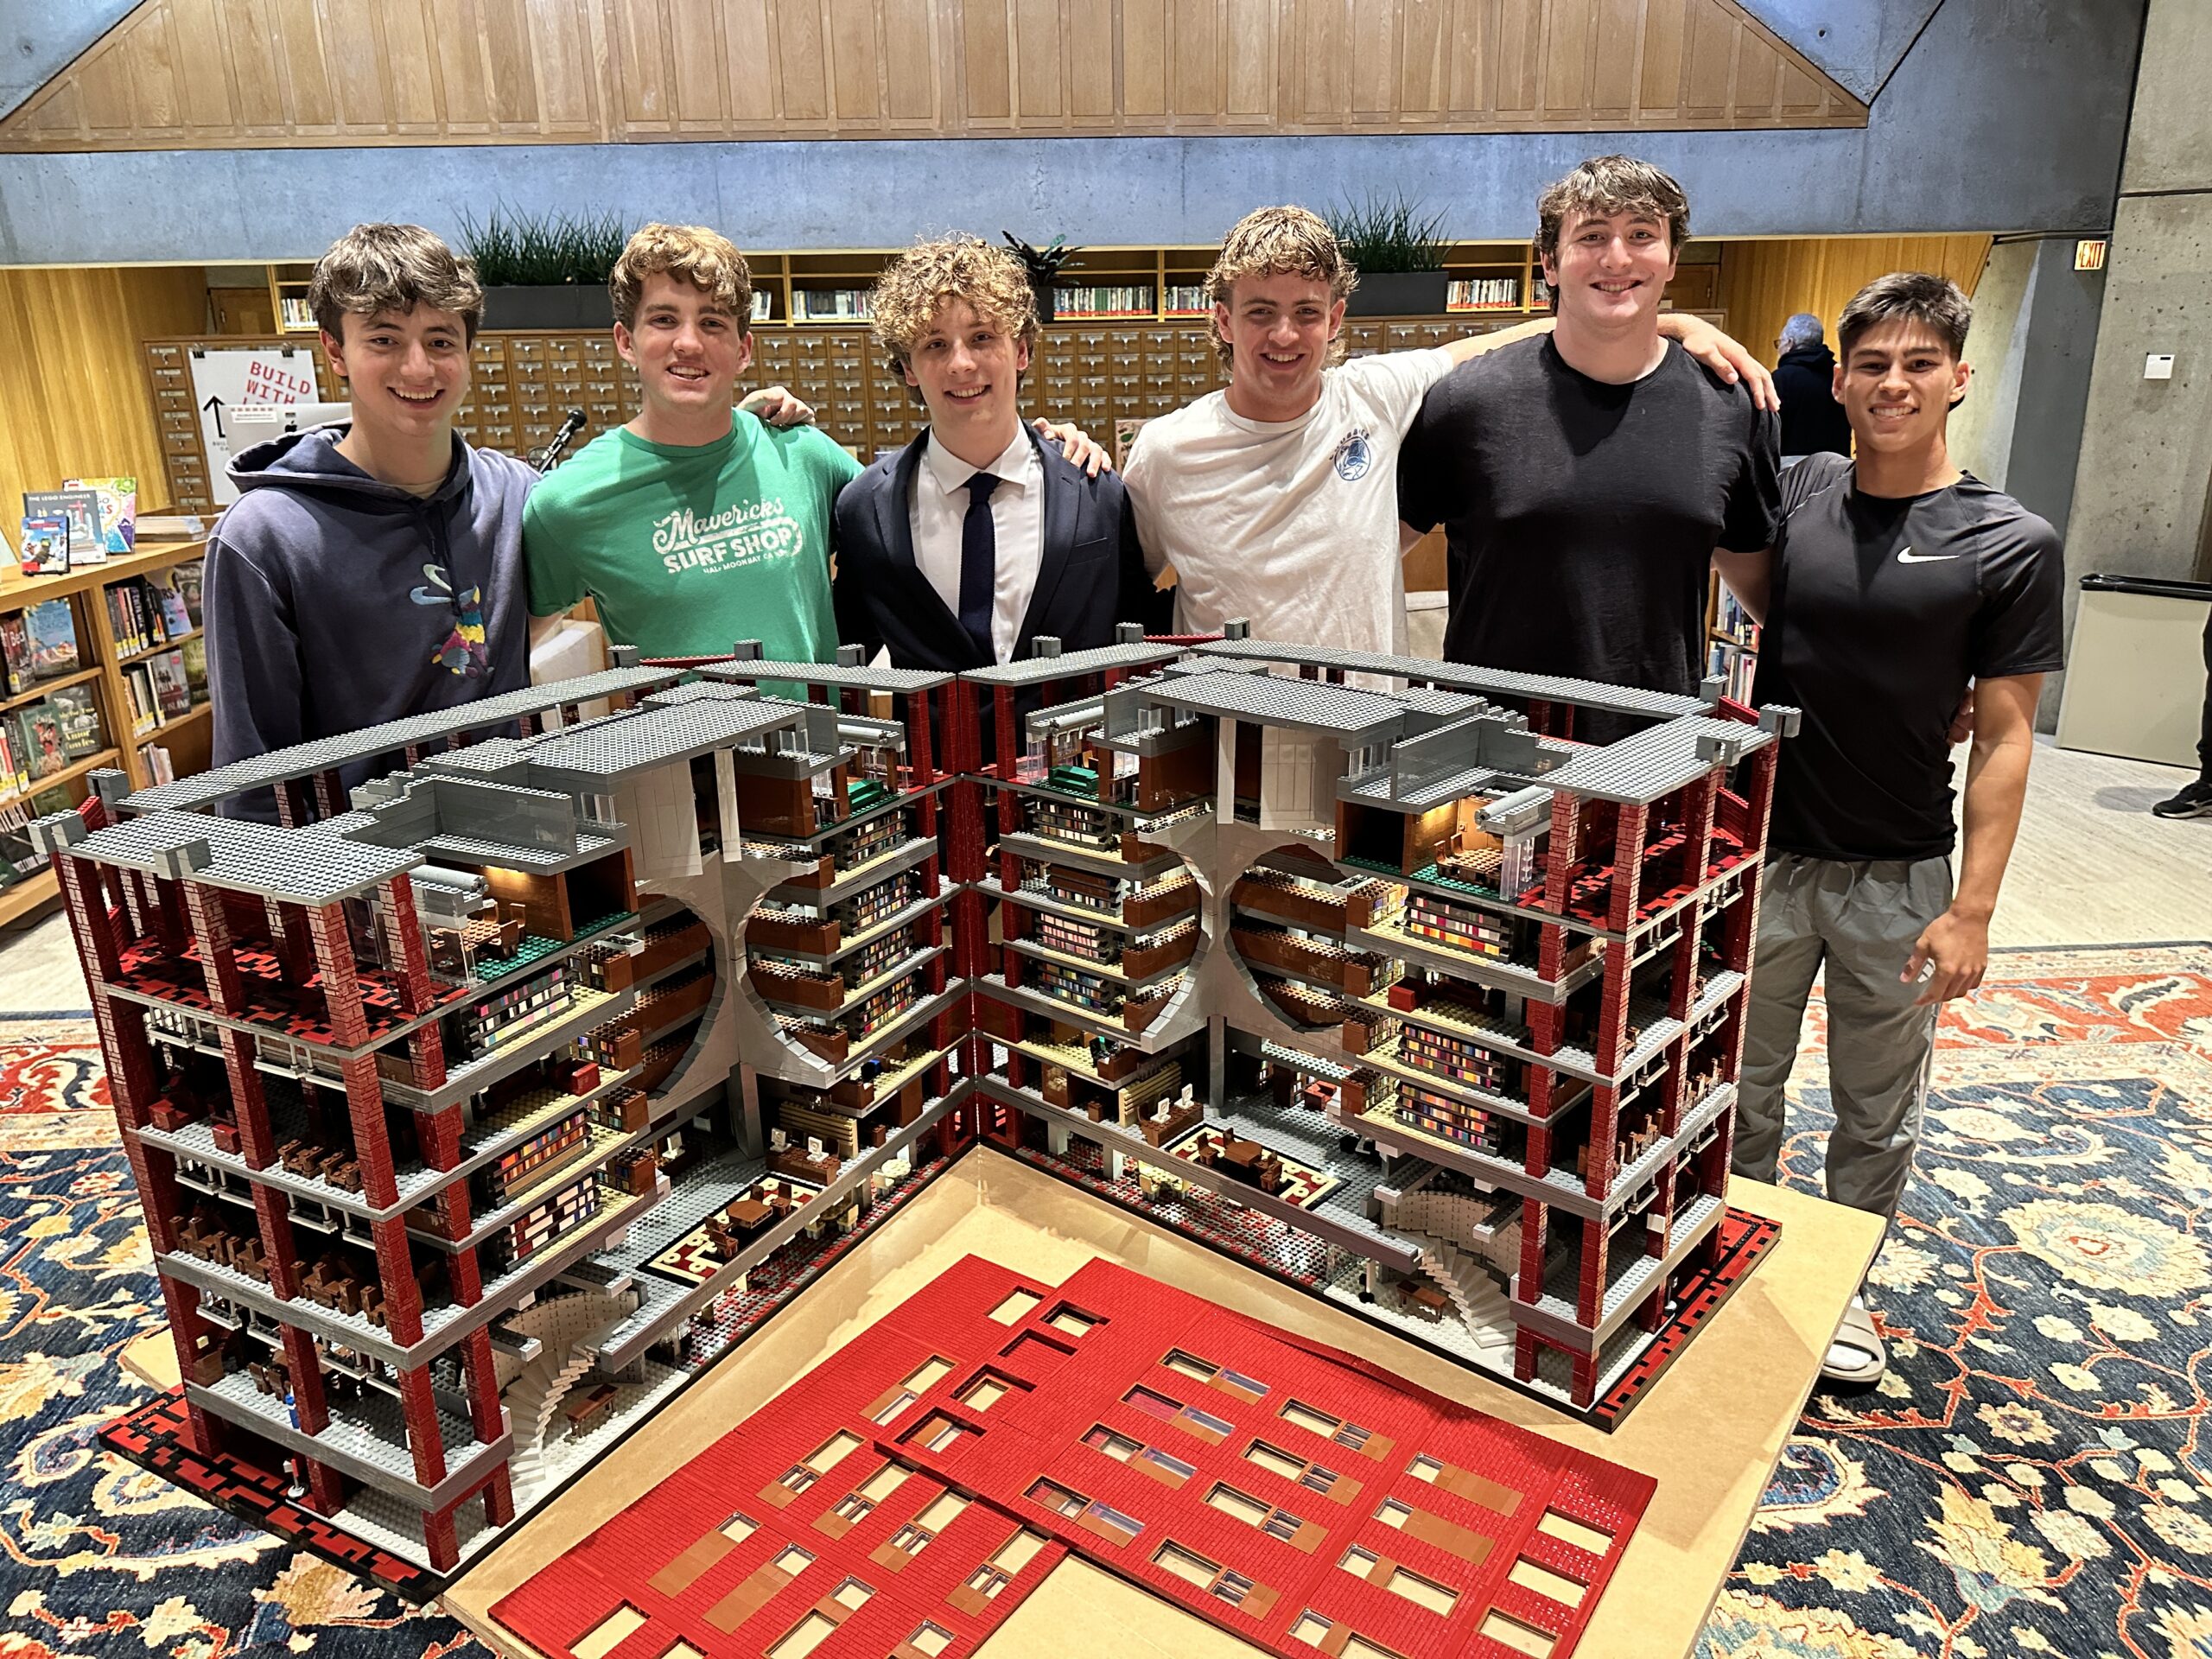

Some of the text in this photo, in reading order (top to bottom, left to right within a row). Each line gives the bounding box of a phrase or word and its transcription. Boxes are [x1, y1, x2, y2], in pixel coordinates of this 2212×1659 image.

[2080, 242, 2105, 268] EXIT
[250, 361, 311, 395] BUILD
[246, 379, 296, 404] WITH
[652, 497, 785, 554] Mavericks
[663, 527, 792, 574] SURF SHOP
[723, 558, 748, 571] MOON
[747, 555, 761, 566] BAY
[65, 729, 91, 741] Amor
